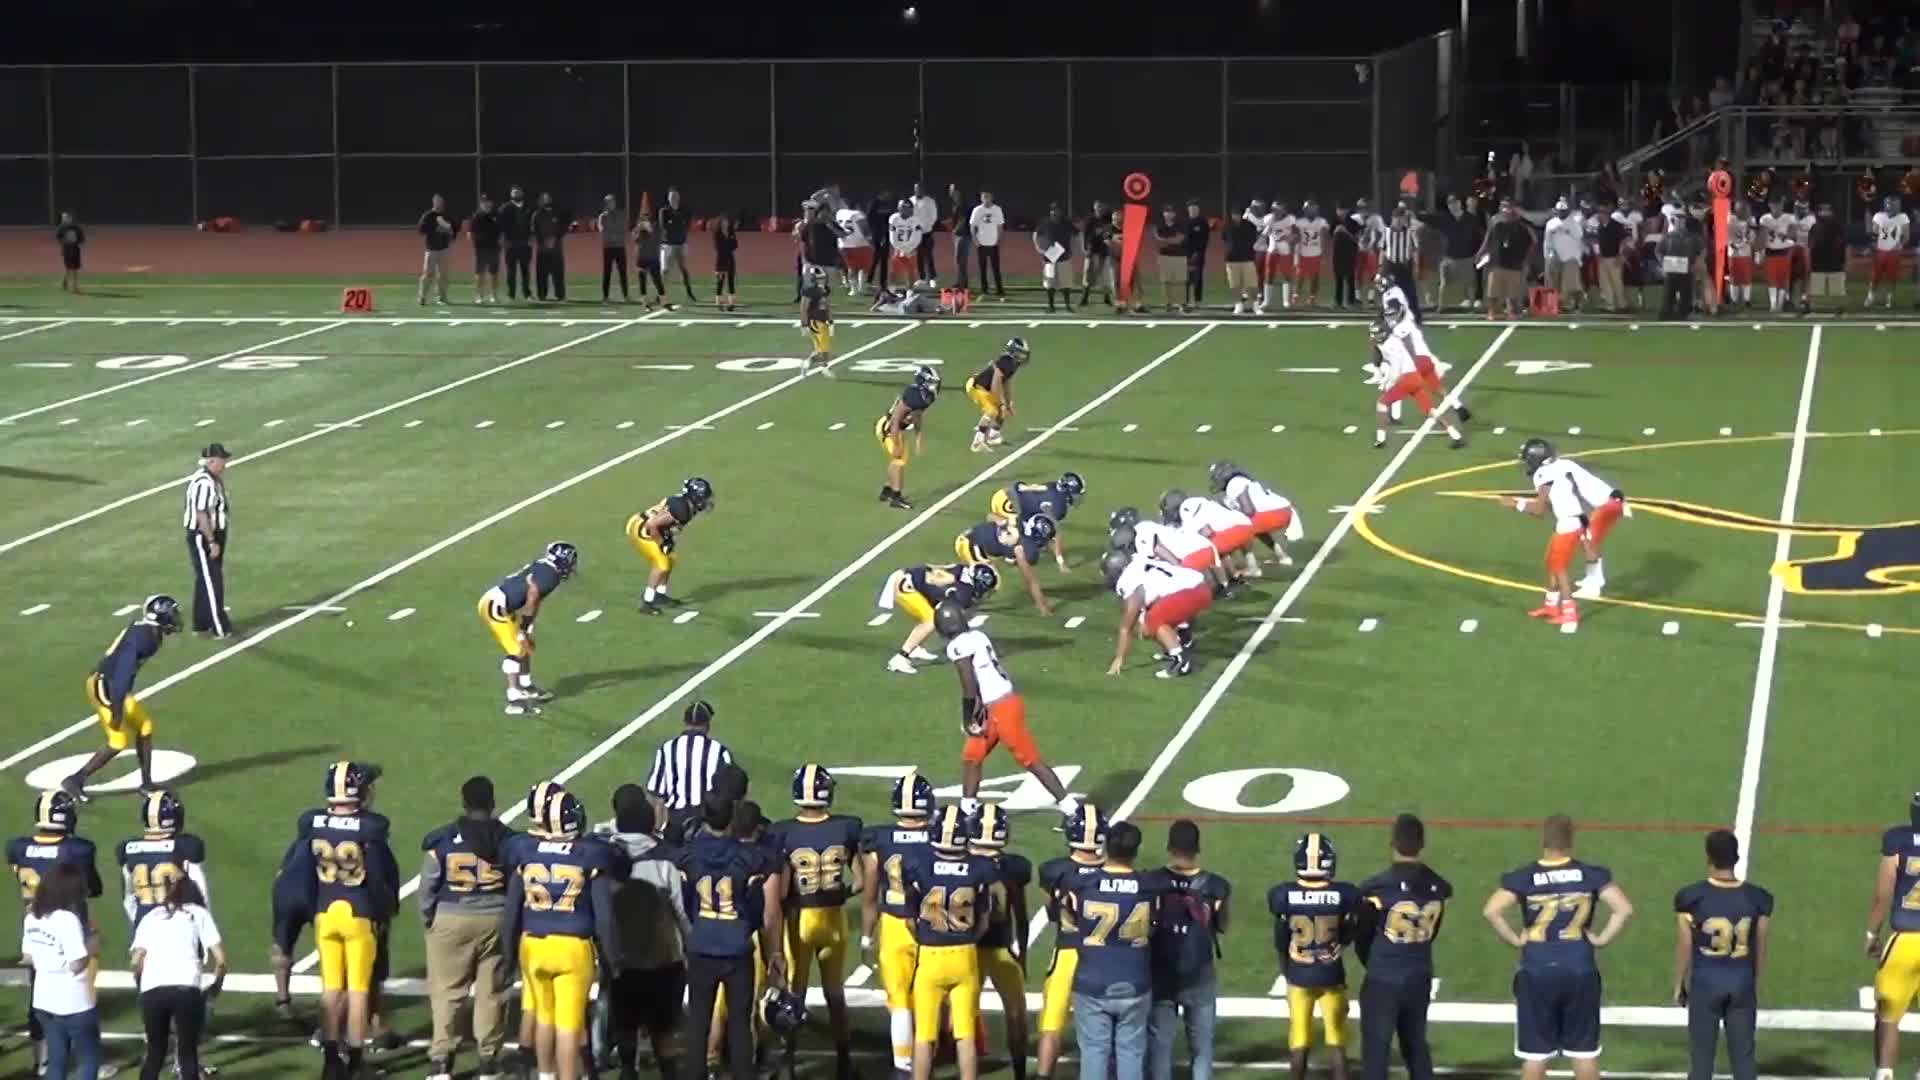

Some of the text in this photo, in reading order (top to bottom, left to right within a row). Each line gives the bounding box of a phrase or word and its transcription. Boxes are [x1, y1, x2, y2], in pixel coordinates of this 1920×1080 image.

[344, 290, 367, 308] 20
[521, 863, 585, 913] 67
[933, 861, 969, 877] GOMEZ
[695, 875, 739, 921] 11
[1526, 892, 1593, 942] 77
[1082, 899, 1151, 947] 74
[1700, 916, 1752, 958] 31
